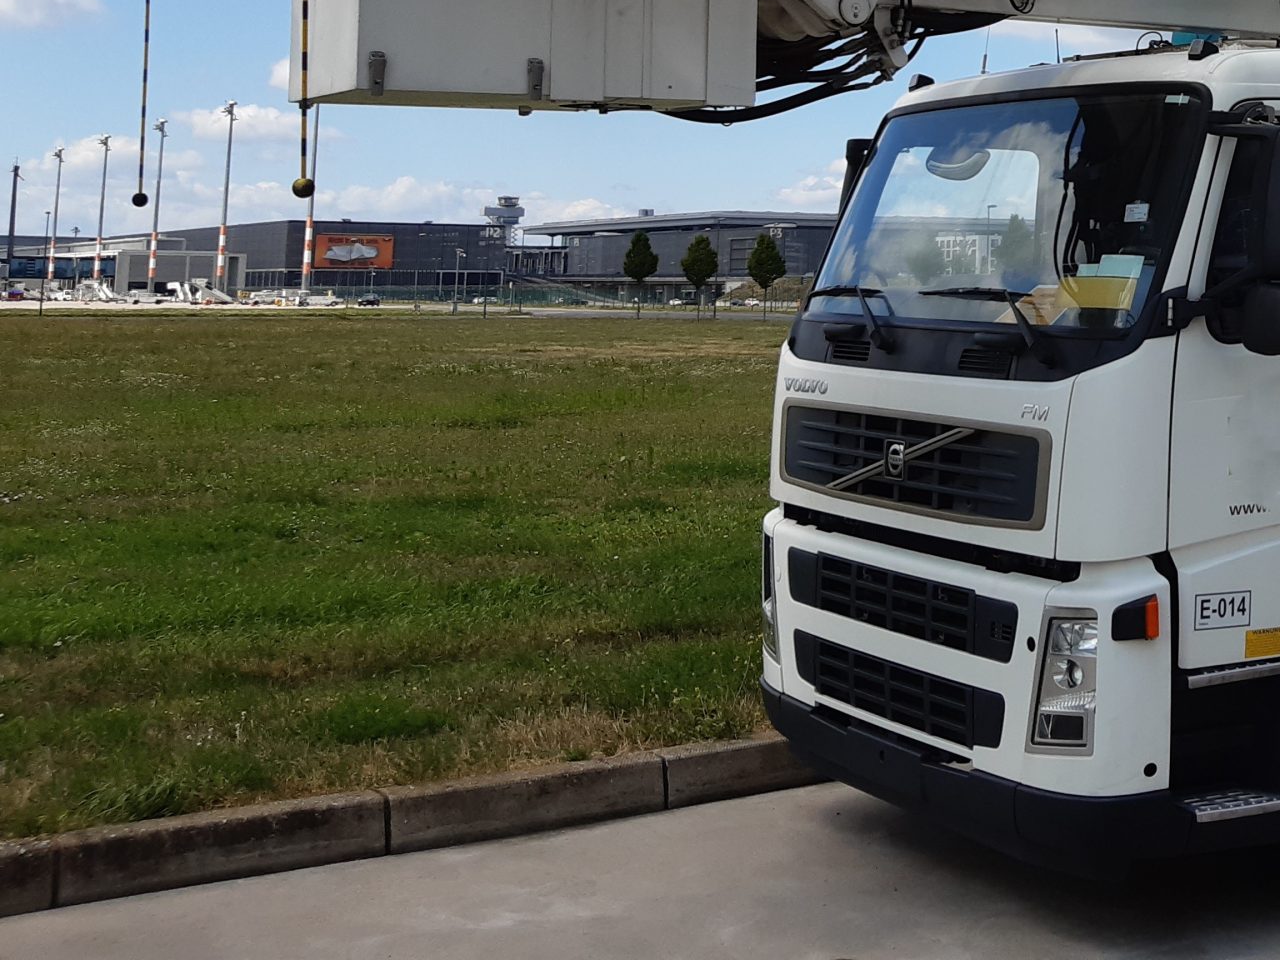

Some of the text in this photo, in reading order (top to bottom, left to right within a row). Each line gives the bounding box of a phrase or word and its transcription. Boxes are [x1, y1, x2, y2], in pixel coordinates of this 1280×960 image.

[769, 228, 783, 239] P3
[784, 377, 828, 394] VOLVO
[1020, 403, 1050, 422] FM
[1200, 596, 1247, 620] E-014
